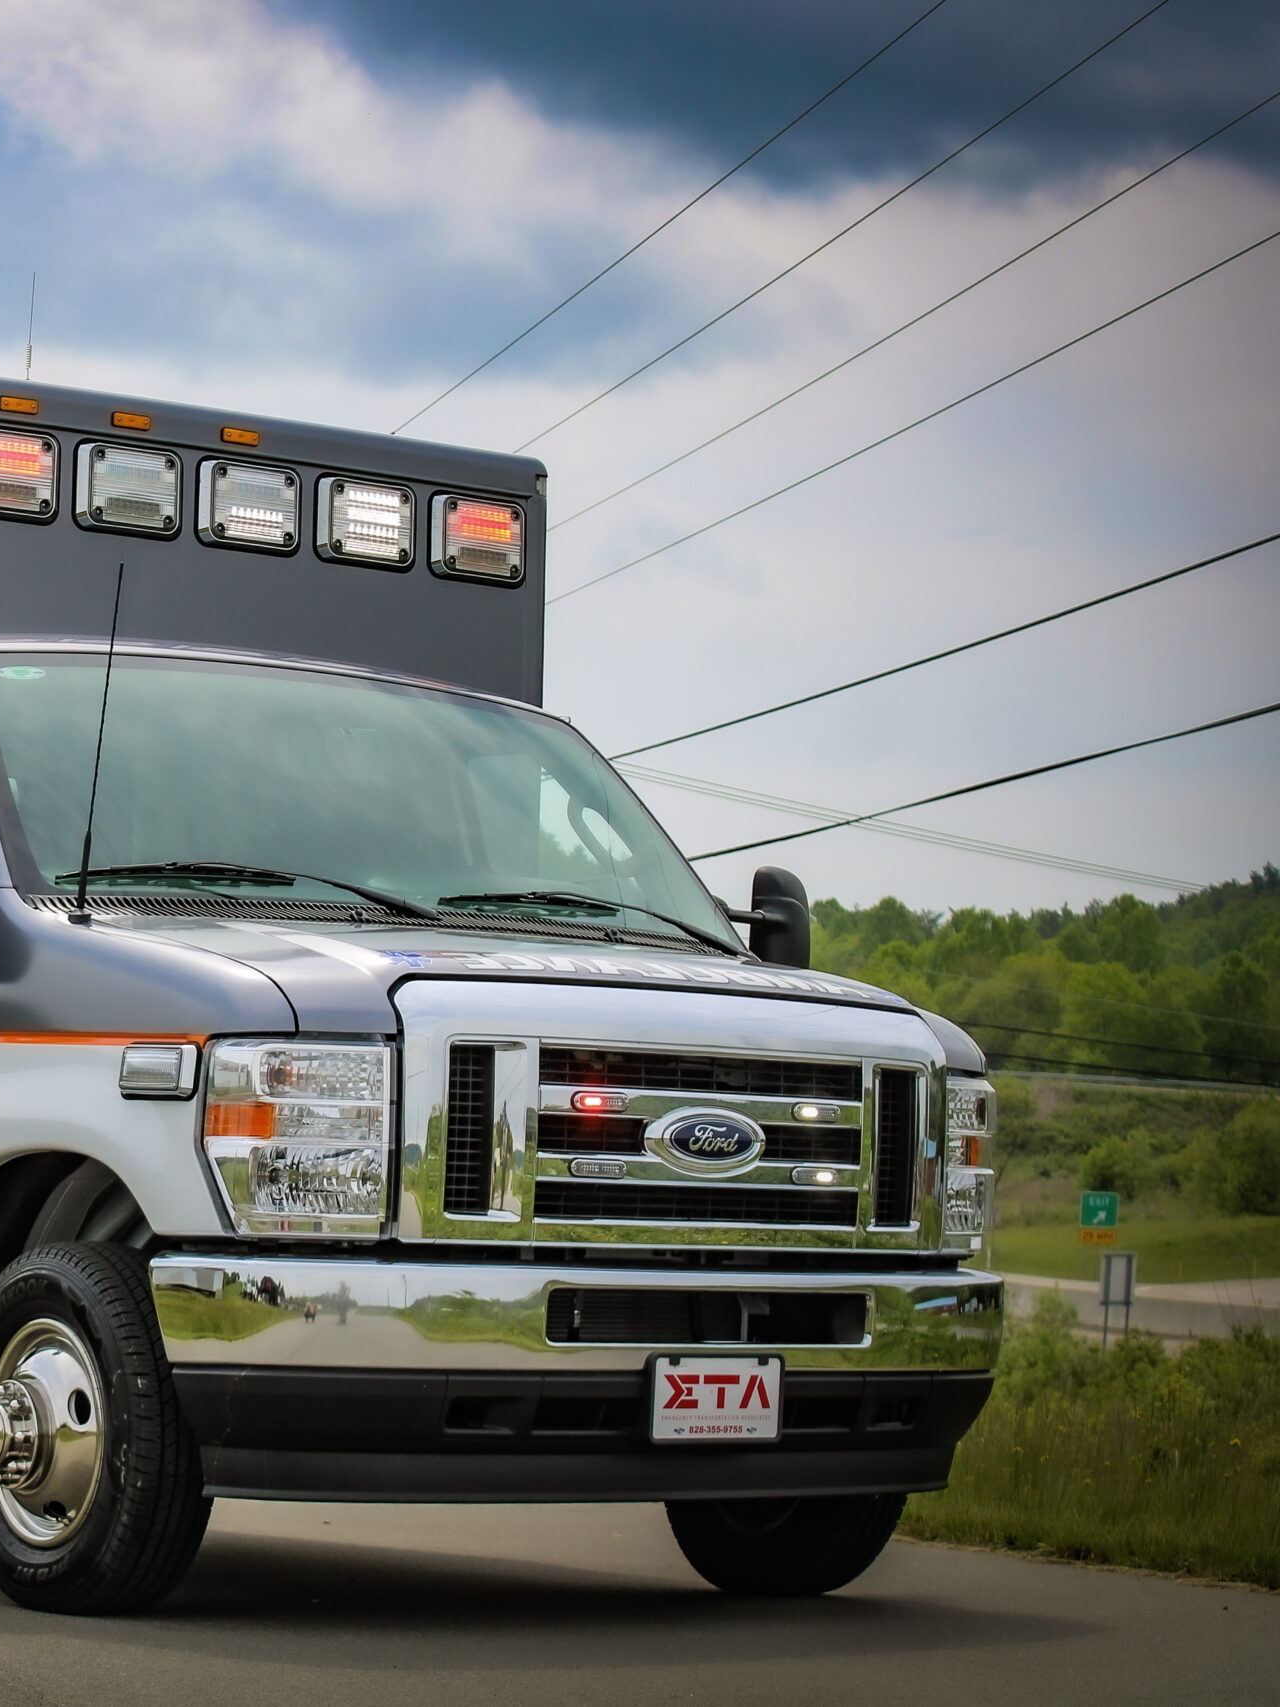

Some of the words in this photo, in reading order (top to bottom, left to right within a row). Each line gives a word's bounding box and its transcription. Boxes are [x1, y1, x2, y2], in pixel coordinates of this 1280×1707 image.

[688, 1124, 739, 1152] Ford
[1089, 1196, 1110, 1206] EXIT
[689, 1425, 743, 1434] 828-355-9755
